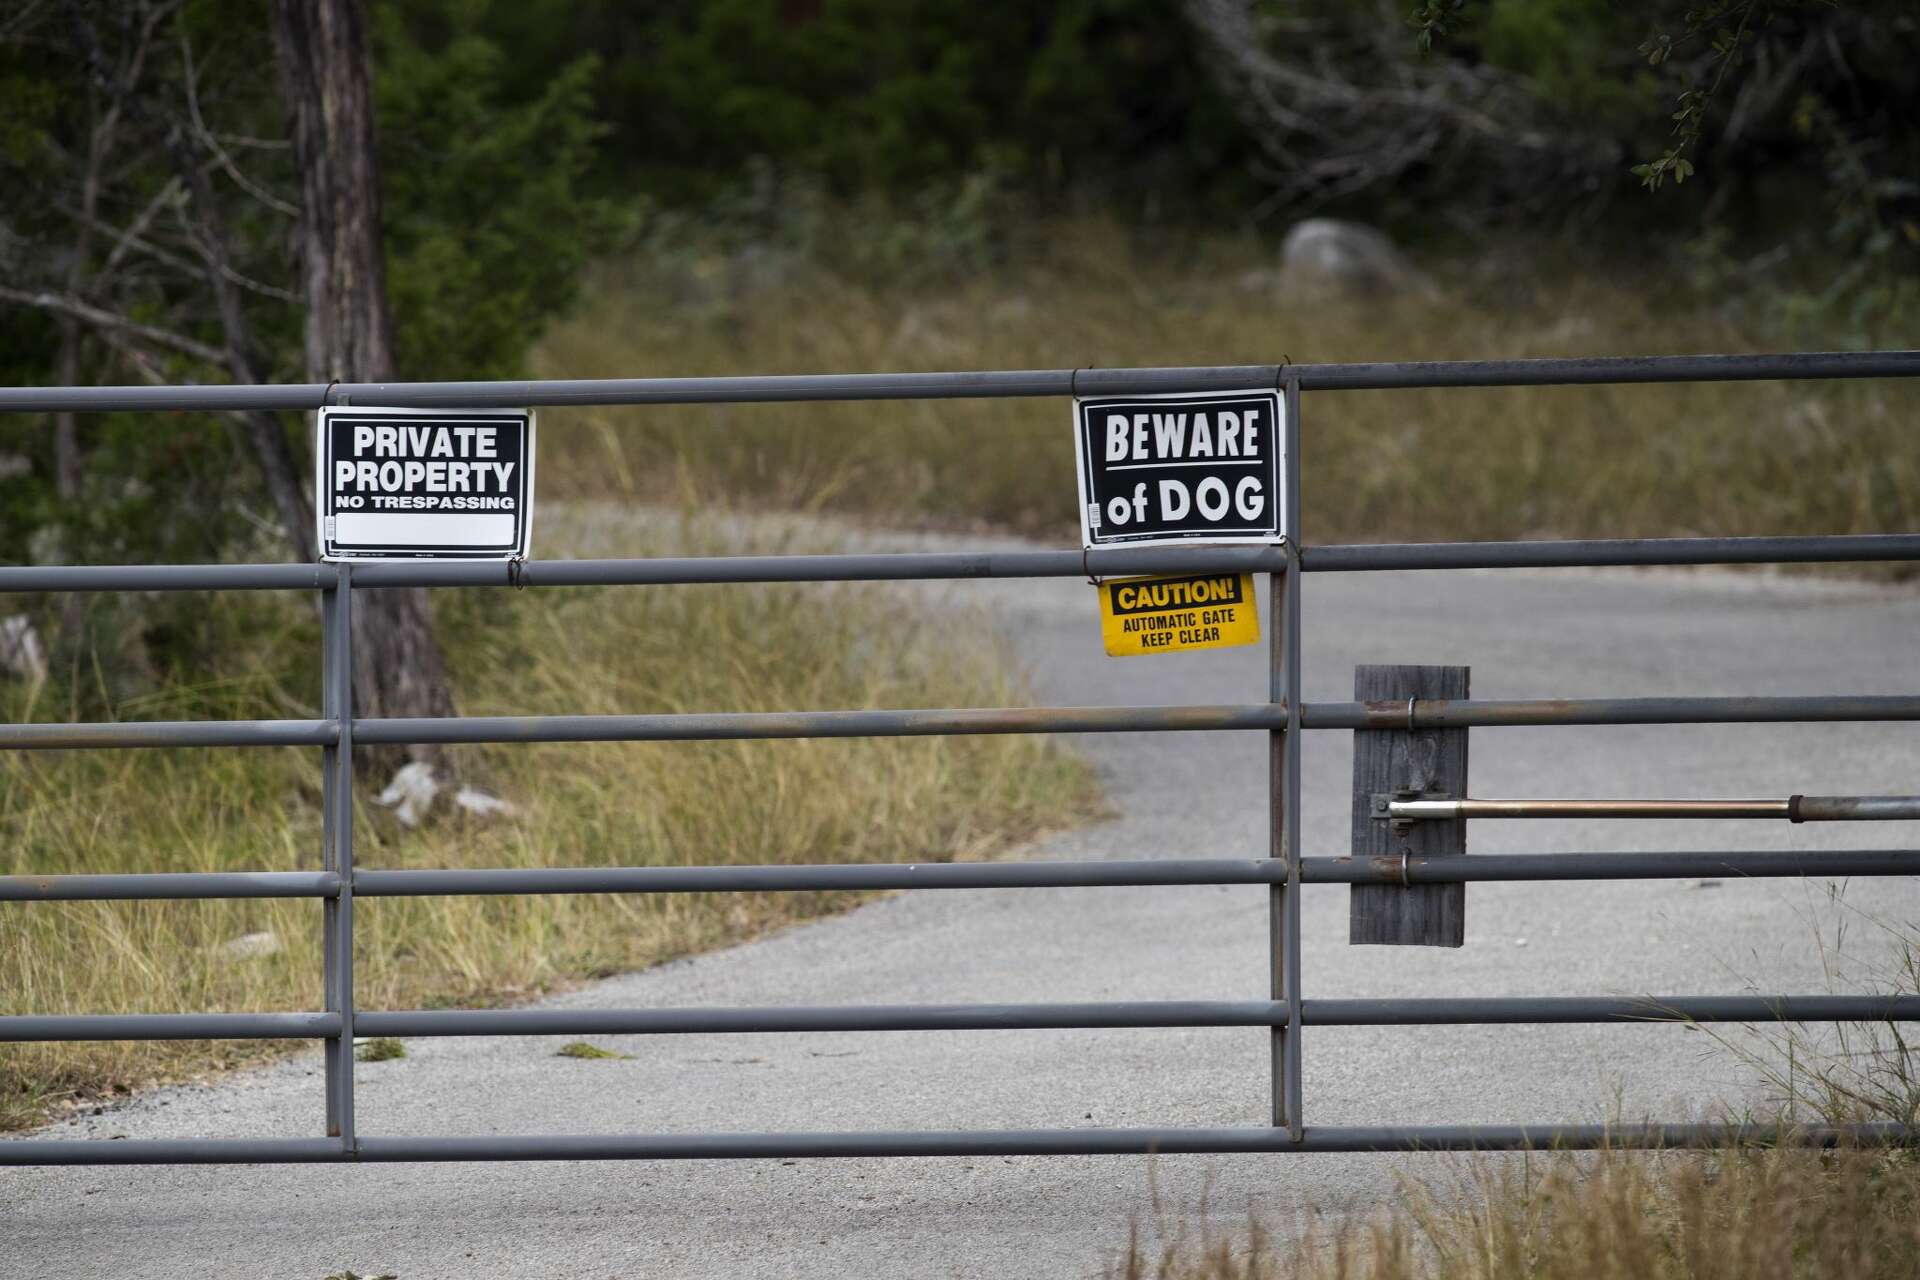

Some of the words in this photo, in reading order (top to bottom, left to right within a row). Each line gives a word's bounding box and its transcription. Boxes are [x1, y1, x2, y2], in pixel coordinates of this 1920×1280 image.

[353, 426, 498, 458] PRIVATE
[1105, 410, 1260, 462] BEWARE
[335, 460, 515, 492] PROPERTY
[335, 496, 365, 508] NO
[371, 496, 515, 509] TRESPASSING
[1107, 482, 1148, 525] of
[1158, 476, 1265, 522] DOG
[1118, 577, 1235, 610] CAUTION!
[1123, 612, 1196, 633] AUTOMATIC
[1202, 608, 1236, 625] GATE
[1141, 631, 1173, 648] KEEP
[1179, 626, 1220, 644] CLEAR
